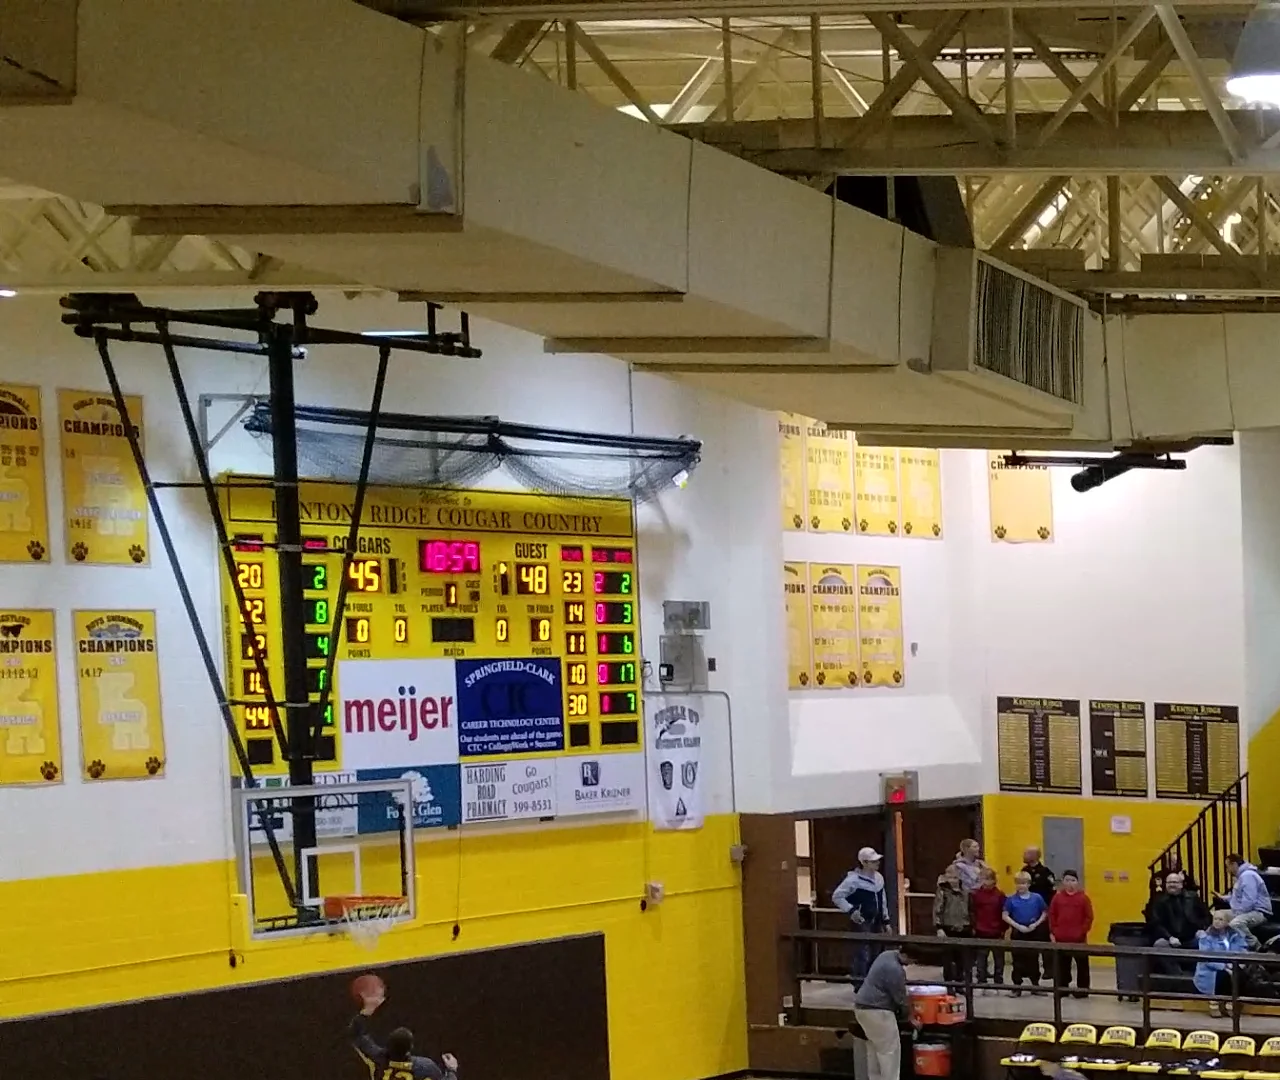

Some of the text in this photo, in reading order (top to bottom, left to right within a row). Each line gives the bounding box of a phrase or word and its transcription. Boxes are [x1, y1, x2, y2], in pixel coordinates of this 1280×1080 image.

[807, 426, 848, 440] CHAMPIONS
[371, 502, 602, 533] RIDGE COUGAR COUNTRY
[333, 535, 391, 554] COGARS
[515, 542, 548, 559] GUEST
[237, 563, 262, 589] 20
[314, 565, 326, 589] 2
[350, 560, 379, 592] 45
[521, 565, 547, 594] 48
[563, 572, 630, 594] 23 2 2
[449, 585, 456, 604] 1
[812, 584, 853, 595] CHAMPIONS
[860, 585, 900, 597] CHAMPIONS
[315, 601, 327, 623] 8
[569, 603, 632, 624] 14 0 3
[356, 619, 369, 642] 0
[395, 619, 406, 642] 0
[496, 619, 507, 641] 0
[539, 619, 550, 641] 0
[79, 639, 154, 653] CHAMPIONS
[317, 636, 329, 656] 4
[570, 634, 633, 654] 11 1 6
[464, 661, 556, 688] SPRINGFIELD-CLARK
[571, 663, 634, 685] 10 0 17
[568, 693, 635, 716] 30 1 7
[1013, 697, 1063, 708] KENTON RIDGE
[1091, 700, 1142, 711] KENTON RIDGE
[1170, 704, 1222, 715] KENTON RIDGE
[245, 706, 270, 728] 44
[344, 685, 453, 741] meijer
[461, 717, 560, 729] CAREER TECHNOLOGY CENTER
[466, 766, 506, 785] HARDING
[525, 765, 537, 777] Go
[477, 784, 496, 800] ROAD
[512, 775, 552, 796] Cougars!
[418, 803, 442, 817] Glen
[466, 799, 507, 818] PHARMACY
[513, 799, 552, 813] 399-8531
